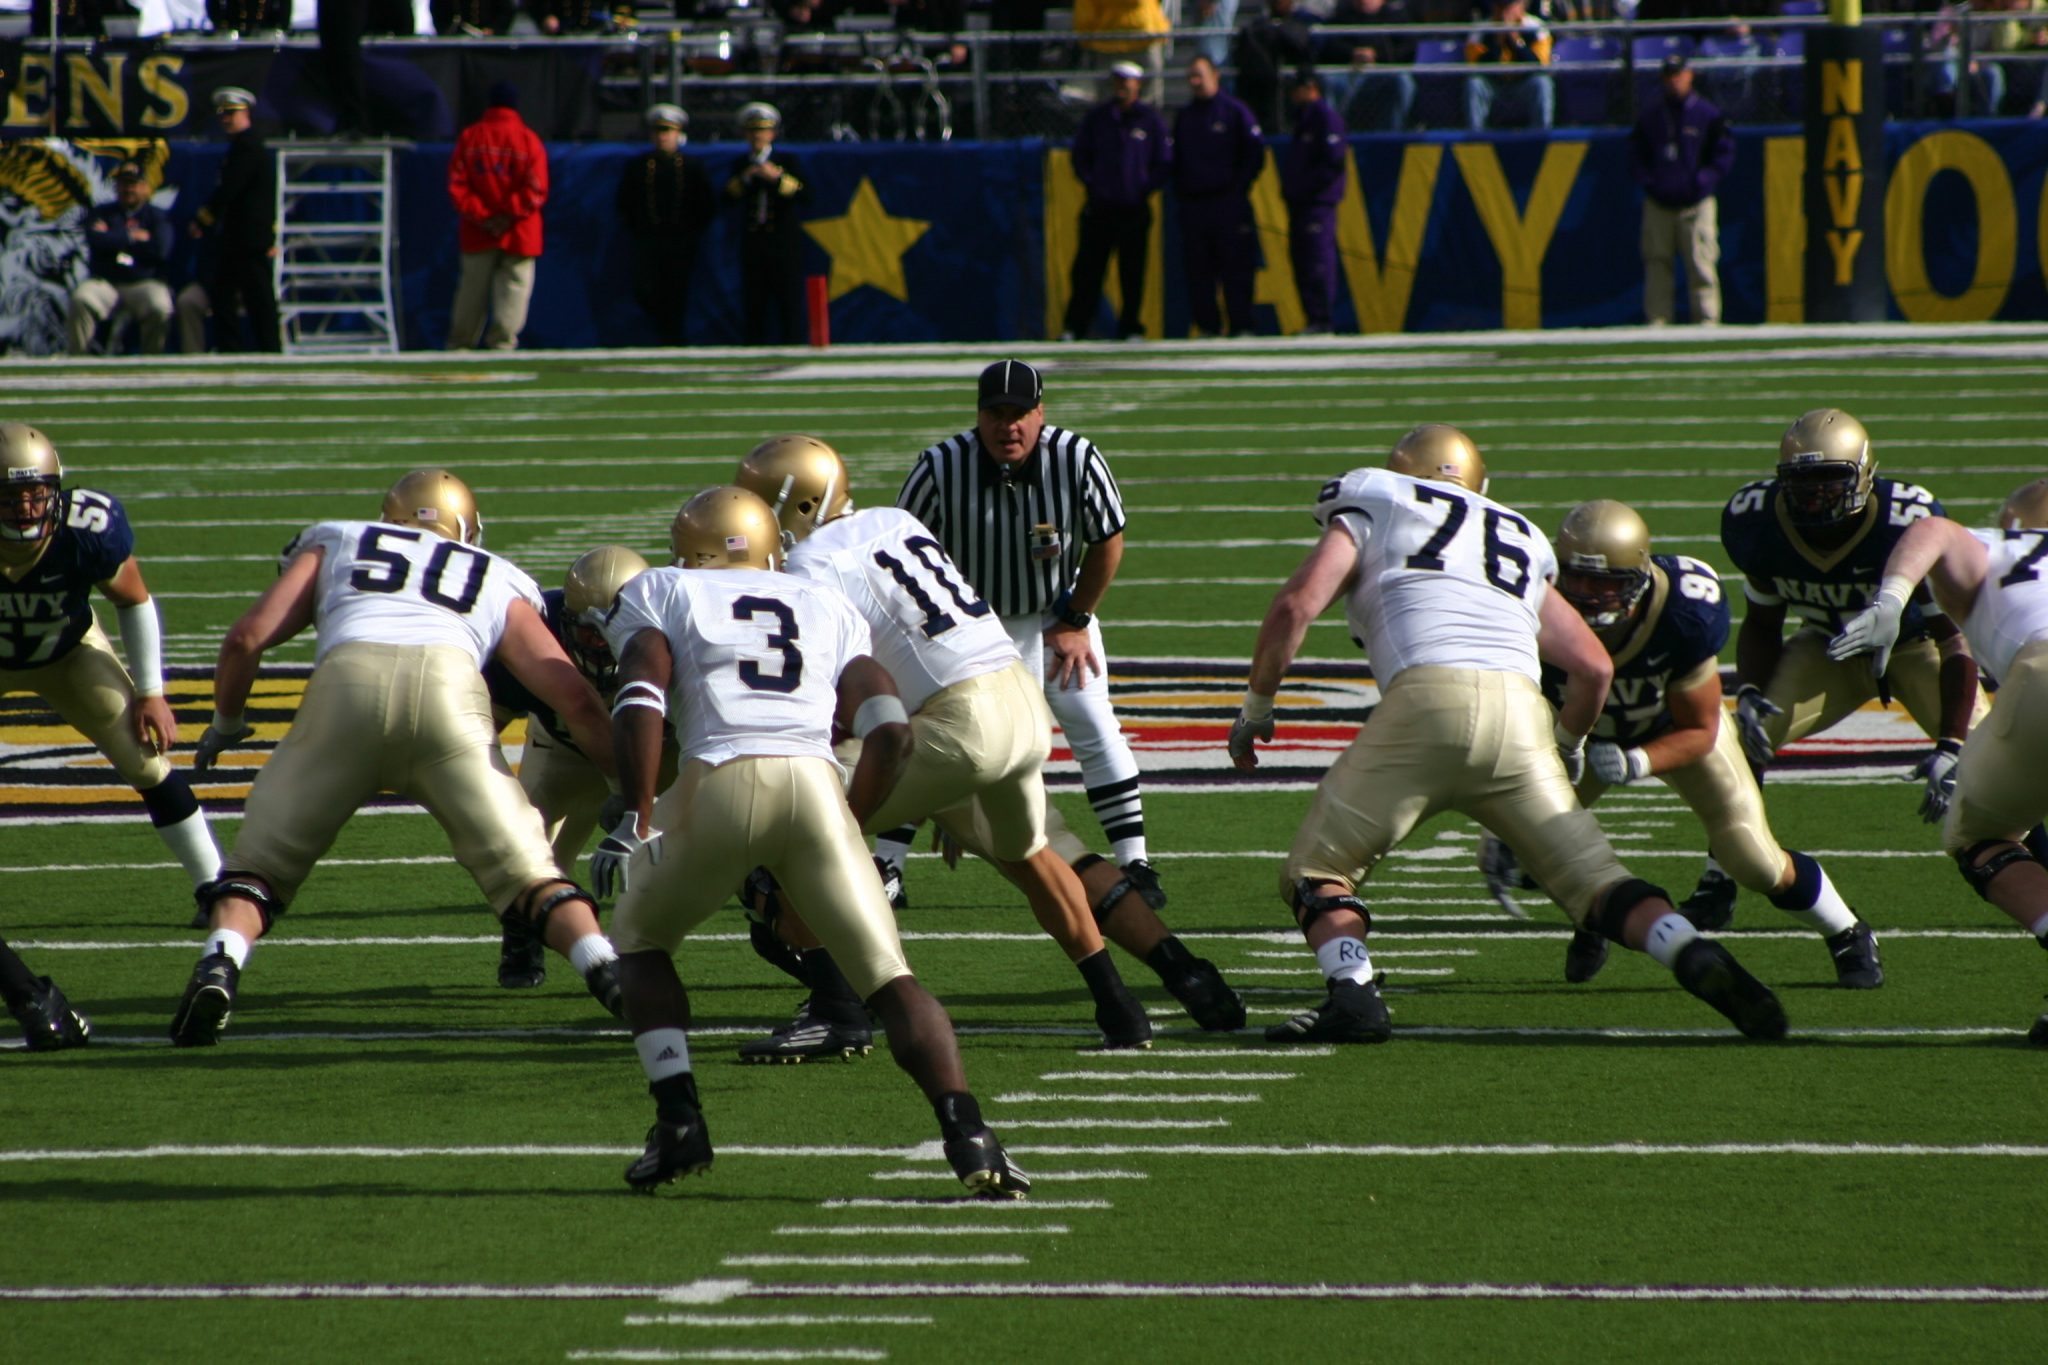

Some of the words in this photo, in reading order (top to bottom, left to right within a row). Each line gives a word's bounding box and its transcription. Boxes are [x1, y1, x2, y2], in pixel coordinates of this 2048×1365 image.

[3, 54, 189, 131] ENS
[1821, 59, 1864, 285] NAVY
[67, 488, 111, 533] 57
[1406, 484, 1531, 599] 76
[1889, 482, 1934, 527] 55
[350, 526, 489, 614] 50
[873, 535, 992, 638] 10
[1676, 555, 1721, 605] 97
[1772, 576, 1881, 608] NAVY
[732, 595, 804, 694] 3
